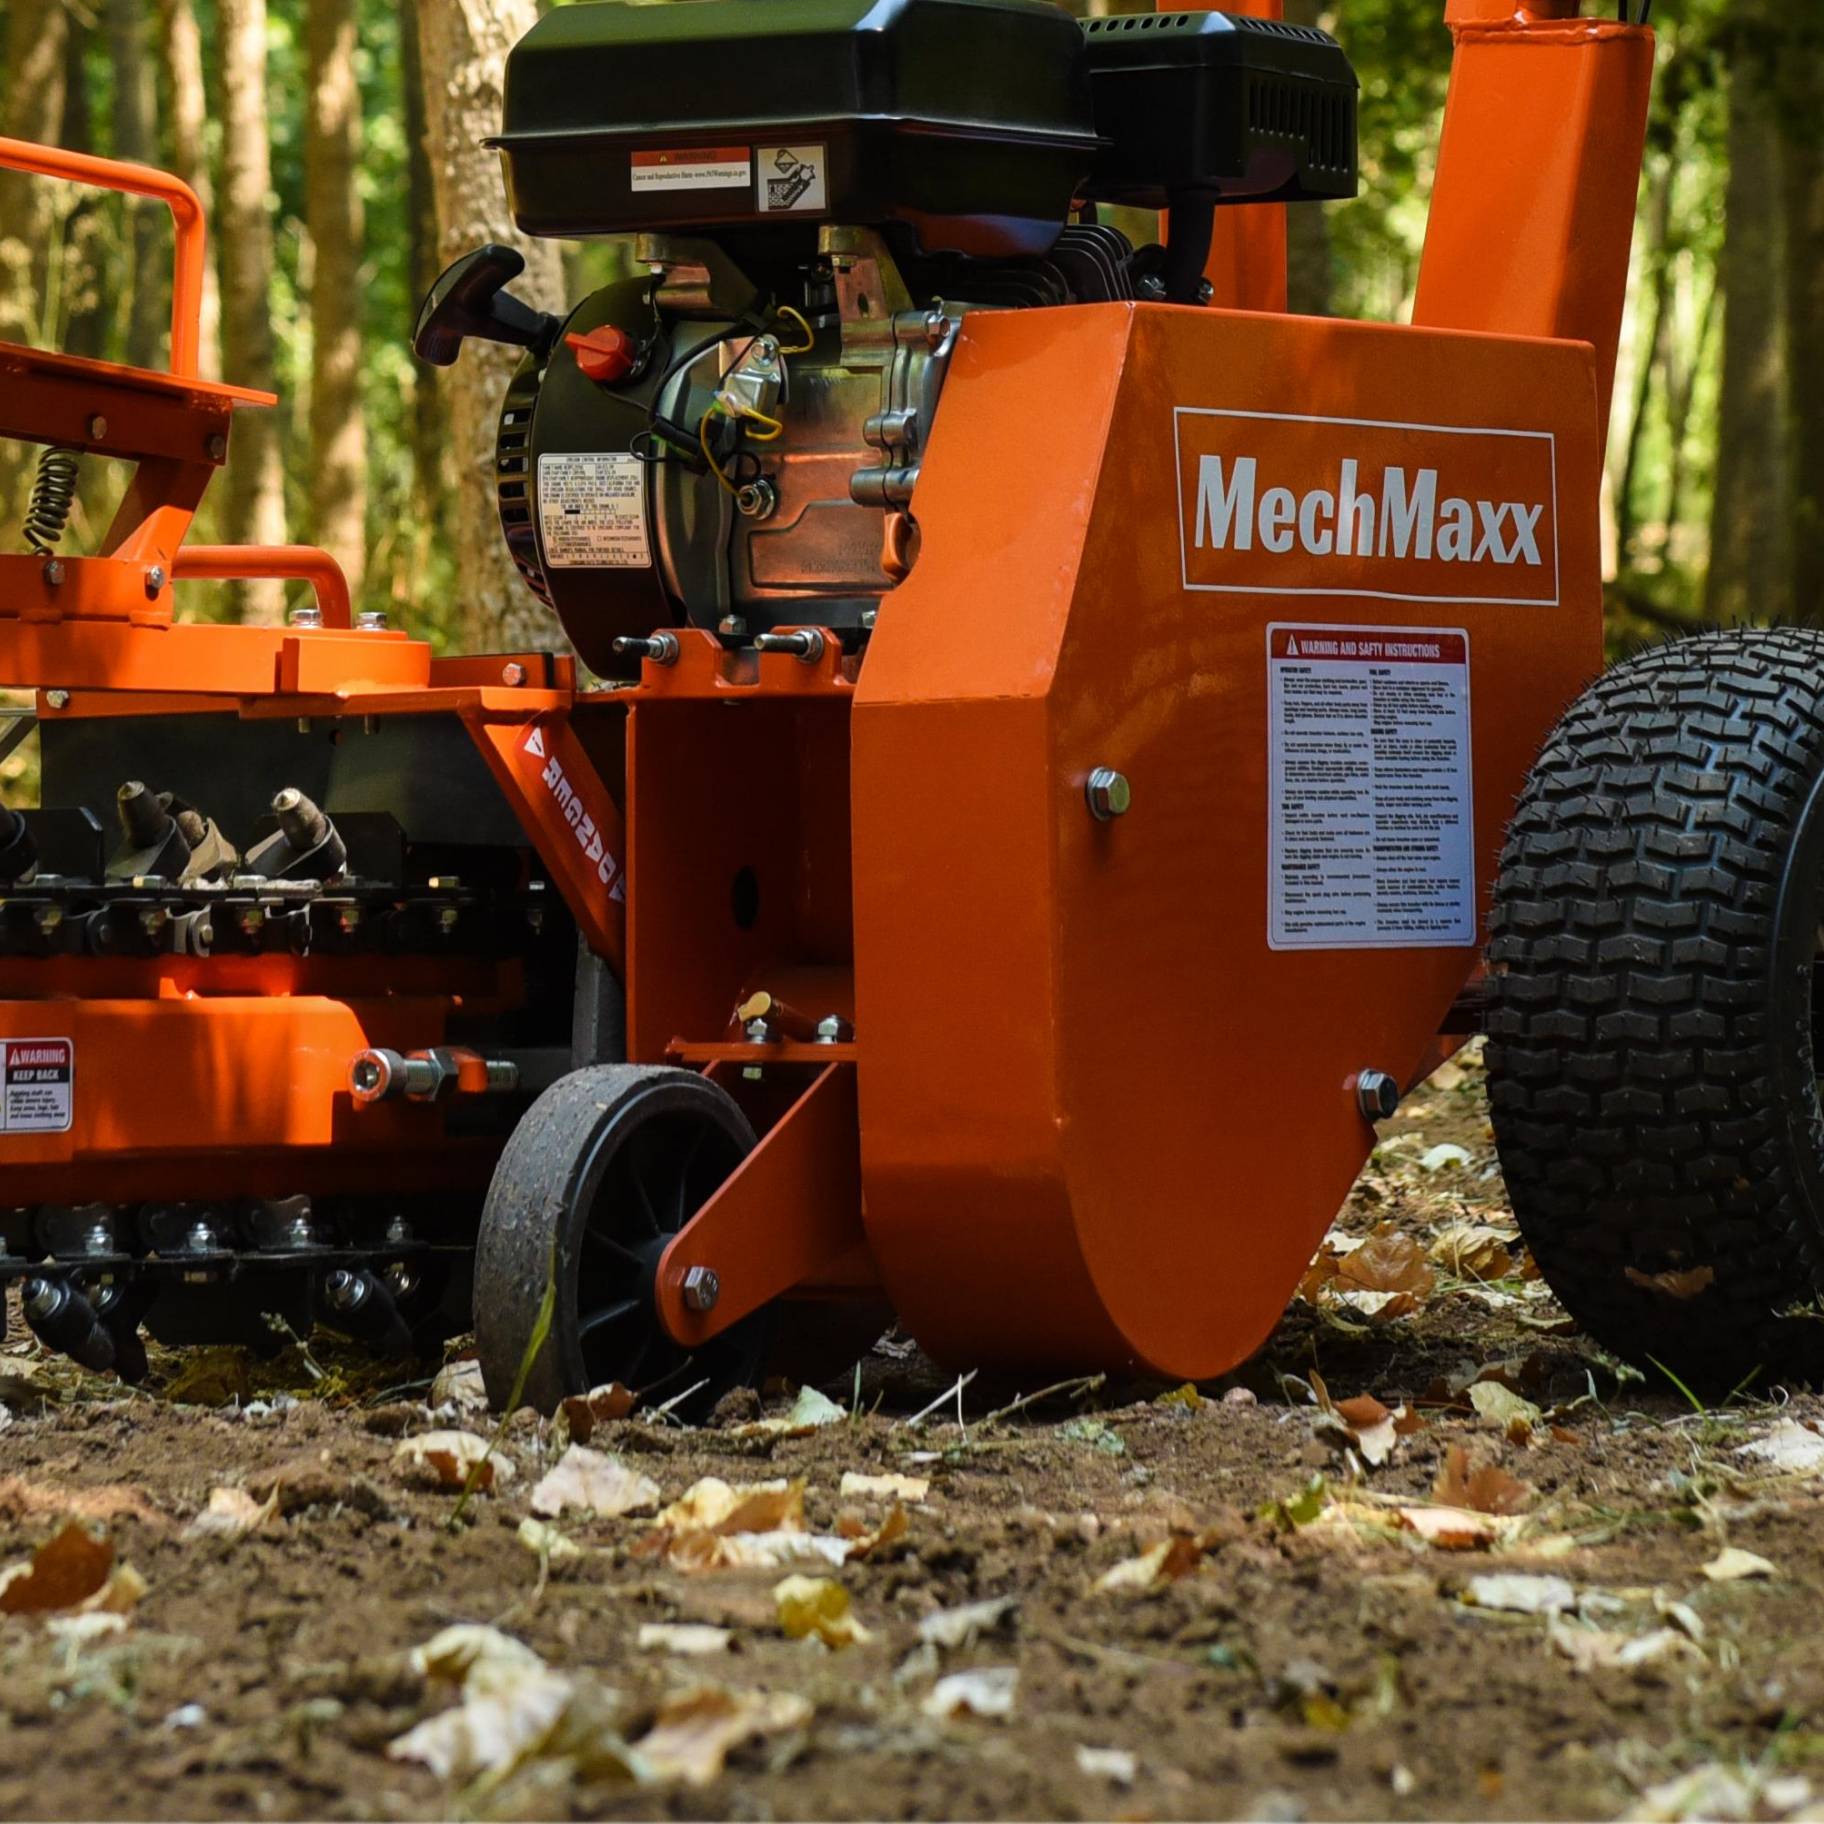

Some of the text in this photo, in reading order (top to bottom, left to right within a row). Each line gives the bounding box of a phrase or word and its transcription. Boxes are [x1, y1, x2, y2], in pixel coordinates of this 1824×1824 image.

[1194, 454, 1543, 566] MechMaxx
[1301, 639, 1440, 658] WARNING AND SAFTY INSTRUCTIONS
[542, 755, 616, 884] DANGER
[20, 1049, 65, 1064] WARNING
[13, 1069, 59, 1081] KEEP BACK
